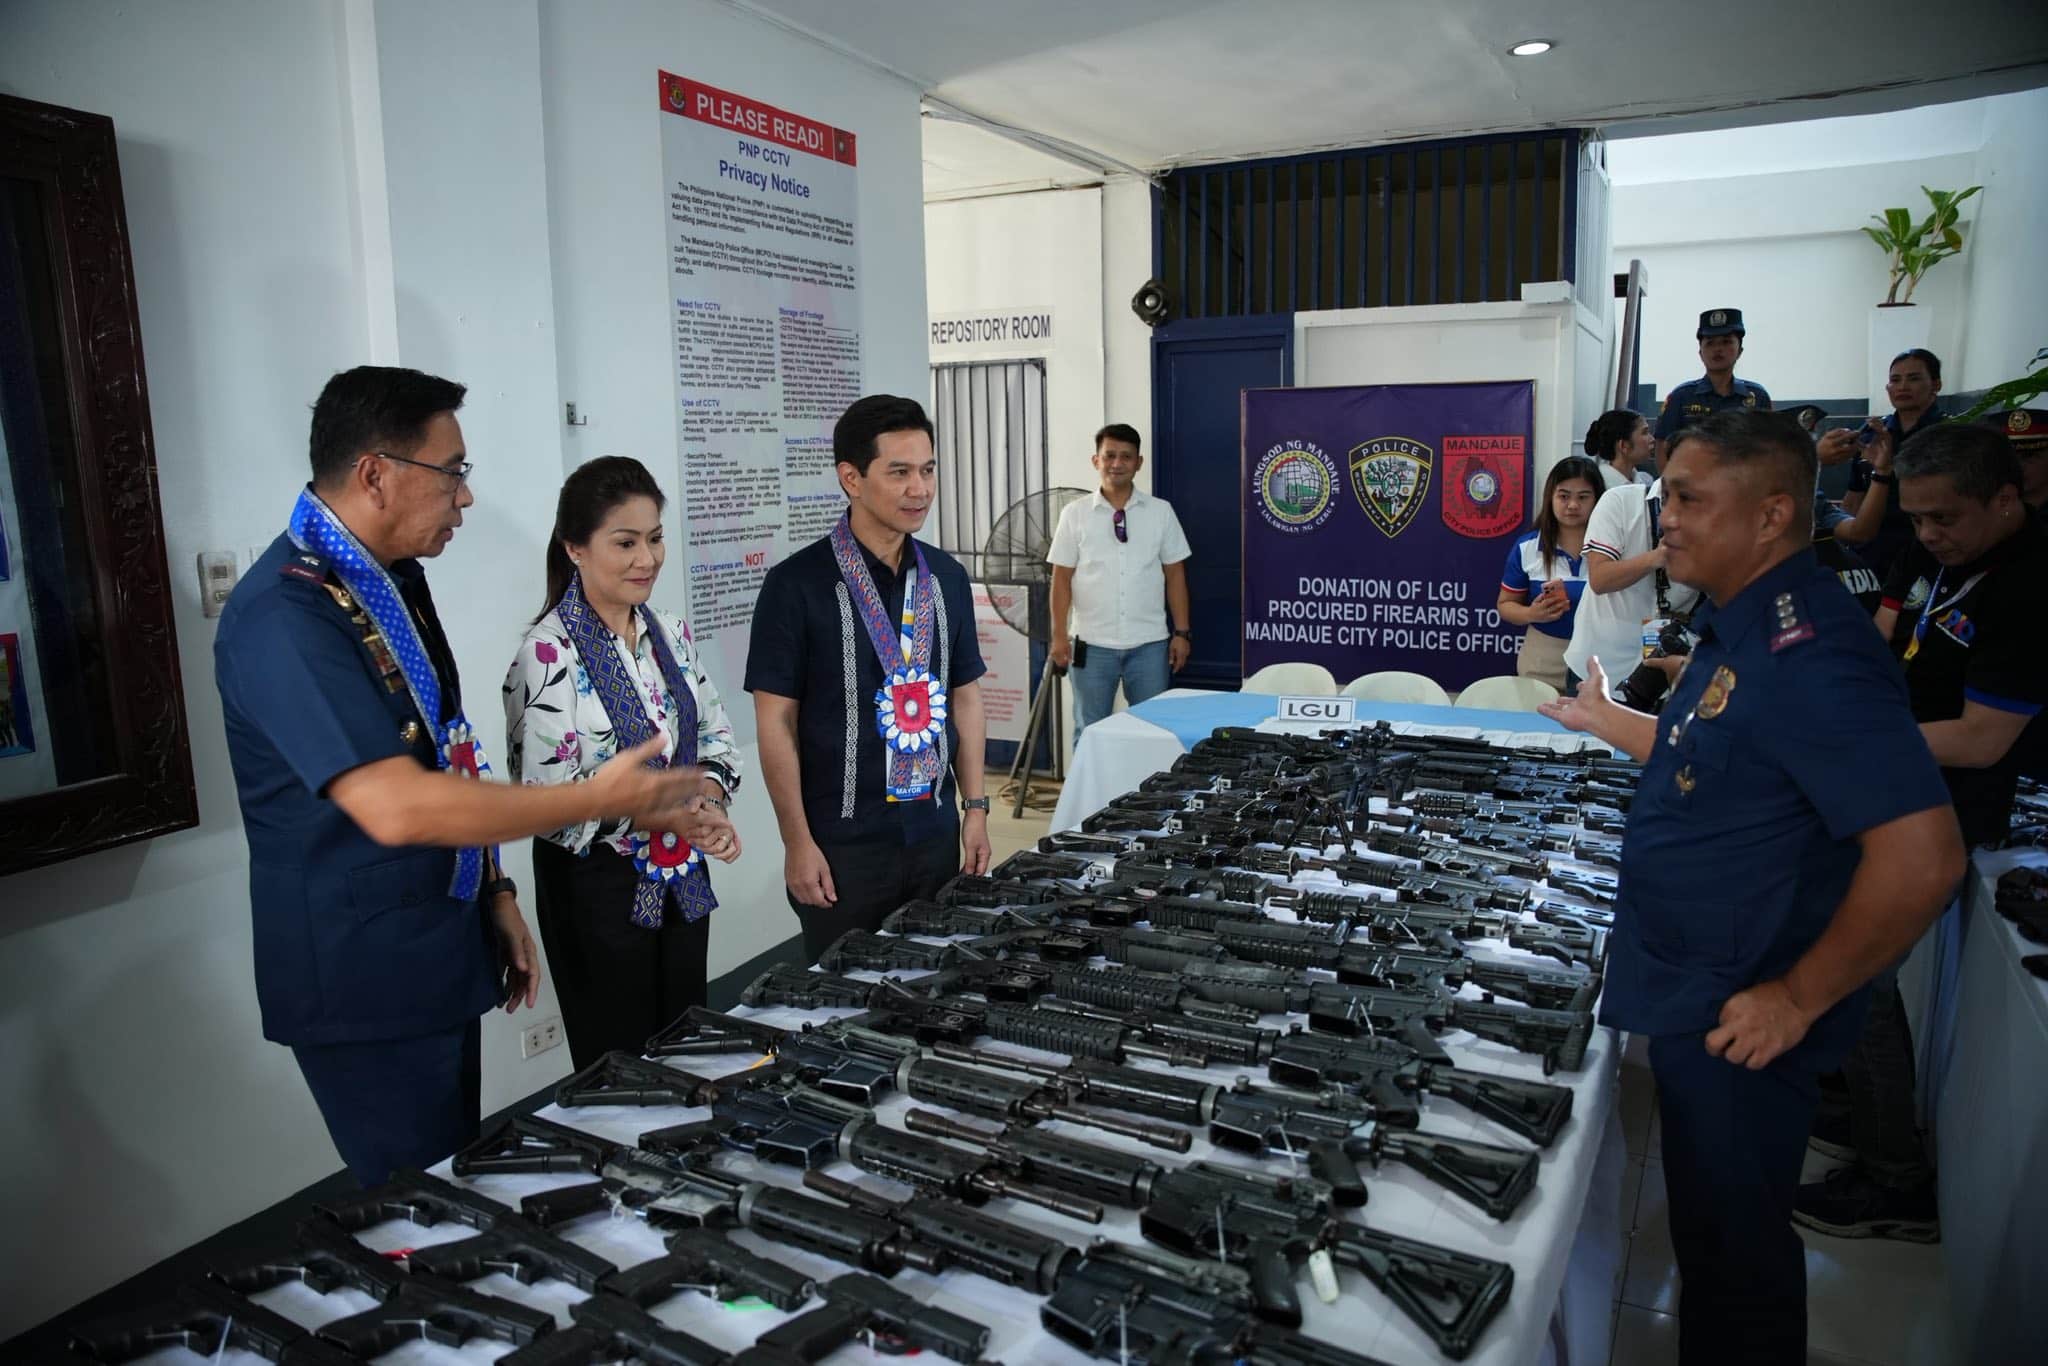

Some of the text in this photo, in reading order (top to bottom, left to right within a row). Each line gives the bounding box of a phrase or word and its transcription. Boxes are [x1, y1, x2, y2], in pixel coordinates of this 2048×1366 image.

[697, 92, 824, 151] PLEASE READ!
[738, 140, 791, 168] PNP CCTV
[719, 159, 810, 200] Privacy Notice
[931, 314, 1051, 344] REPOSITORY ROOM
[1361, 442, 1420, 457] POLICE
[1447, 439, 1521, 450] MANDAUE
[1253, 440, 1340, 495] LUNGSOD NG MANDAUE
[1261, 509, 1299, 533] LALAWIGAN
[745, 552, 766, 567] NOT
[1299, 577, 1467, 601] DONATION OF LGU
[1836, 568, 1881, 594] EDIA
[1268, 600, 1501, 629] PROCURED FIREARMS TO
[1245, 622, 1525, 655] MANDAUE CITY POLICE OFFICE
[1288, 703, 1340, 718] LGU
[895, 786, 922, 795] MAYOR
